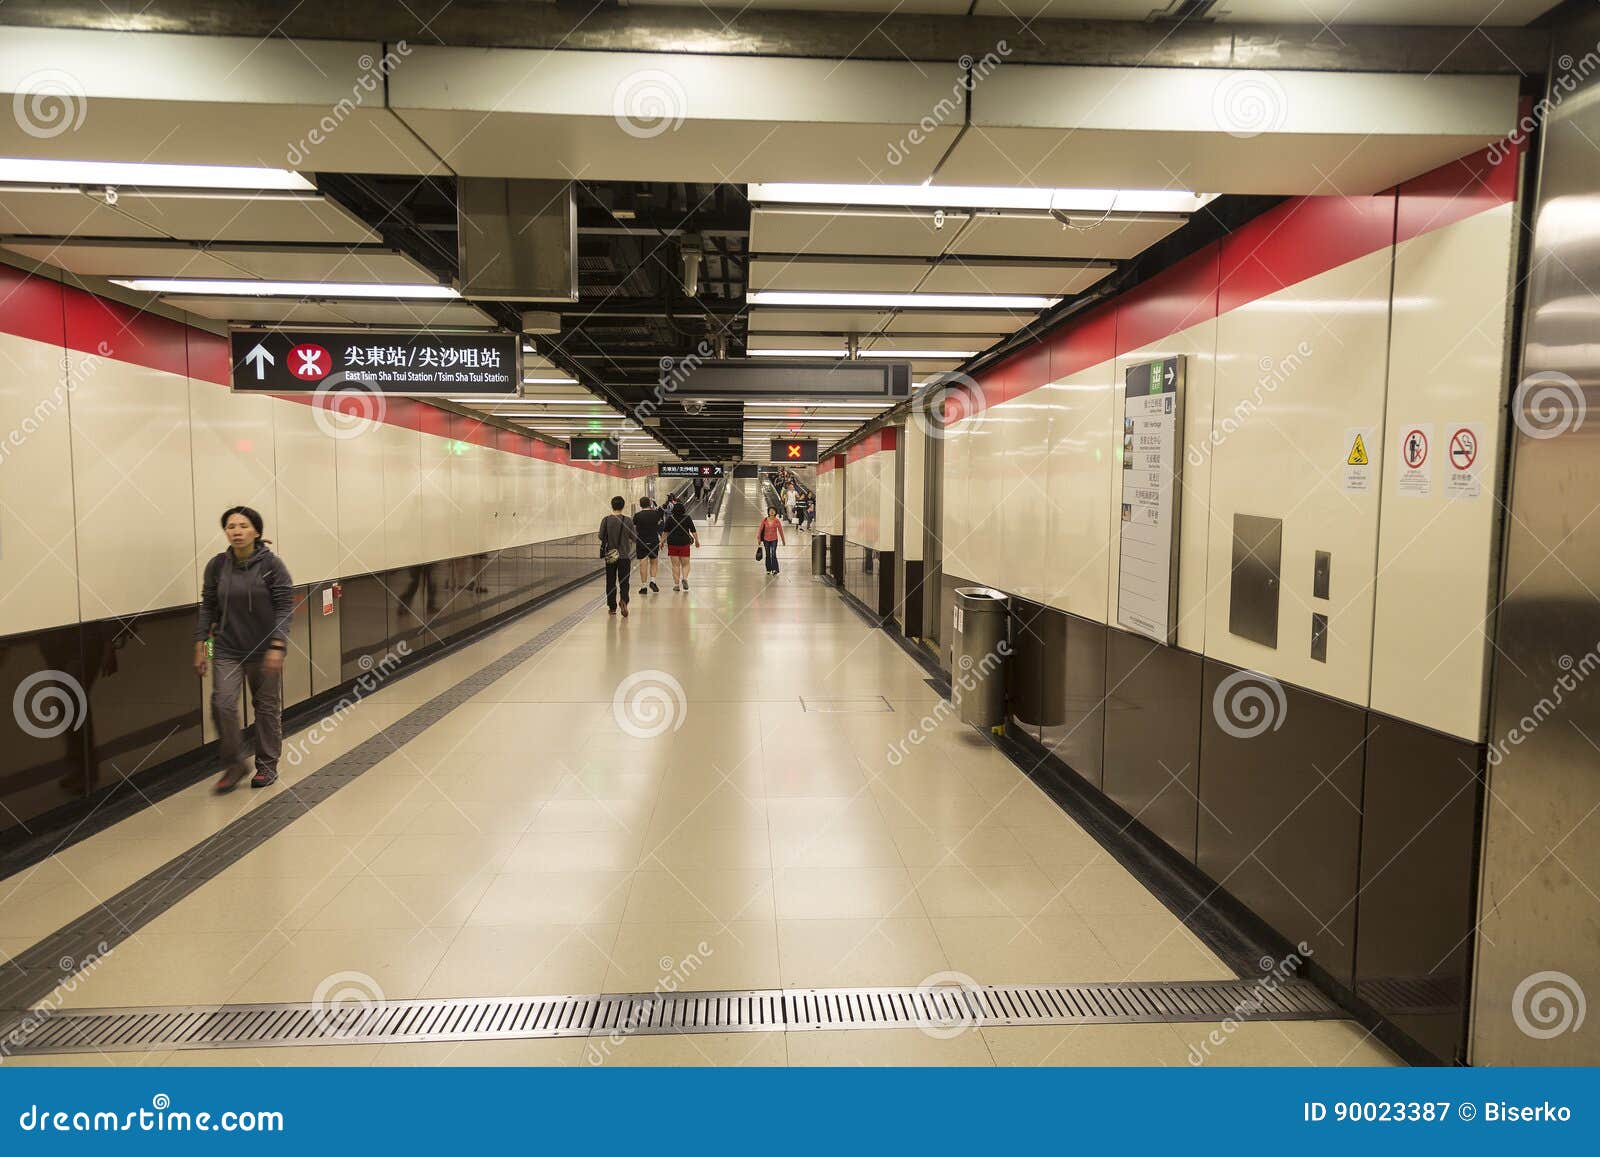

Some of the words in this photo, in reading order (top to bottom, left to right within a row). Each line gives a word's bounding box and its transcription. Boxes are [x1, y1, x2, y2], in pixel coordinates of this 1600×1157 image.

[344, 346, 500, 368] 尖東站/尖沙咀站
[345, 371, 361, 381] East
[361, 371, 377, 381] Tsim
[379, 372, 392, 381] Sha
[392, 372, 407, 381] Tsui
[408, 372, 432, 381] Station
[438, 373, 454, 382] Tsim
[455, 373, 469, 382] Sha
[469, 373, 484, 382] Tsui
[485, 373, 509, 382] Station
